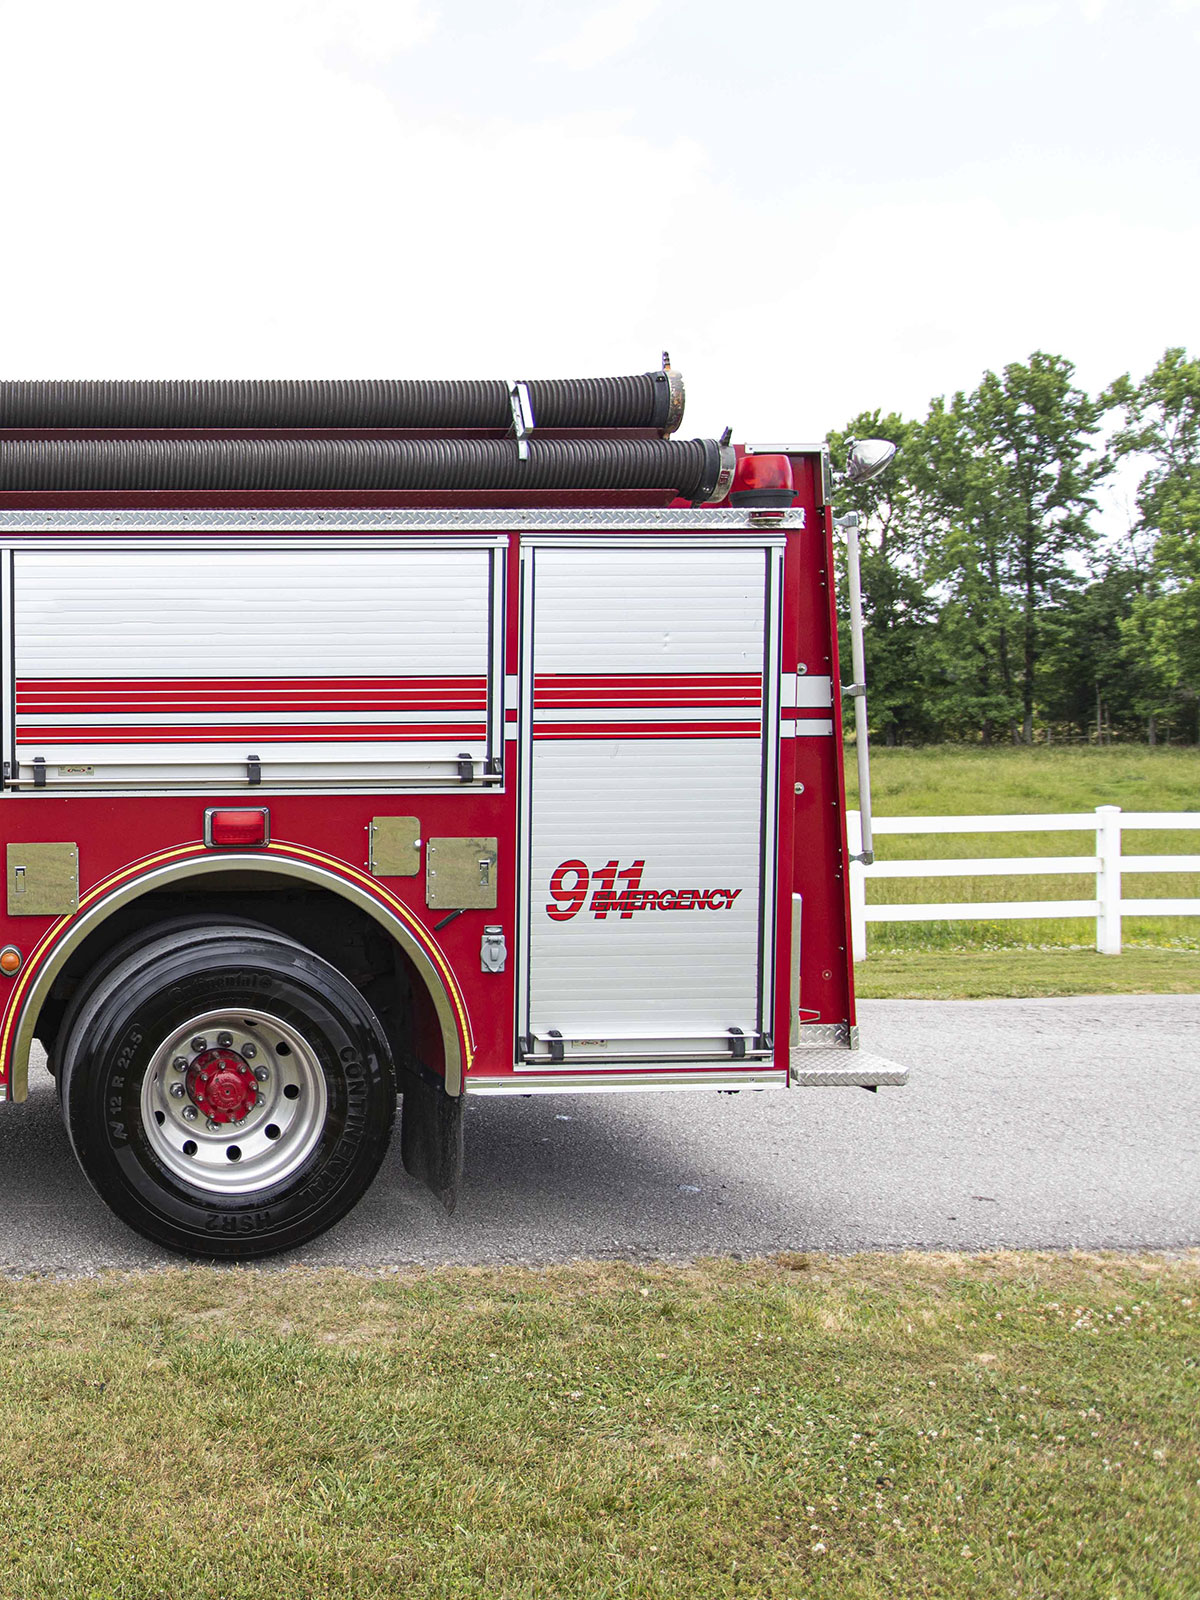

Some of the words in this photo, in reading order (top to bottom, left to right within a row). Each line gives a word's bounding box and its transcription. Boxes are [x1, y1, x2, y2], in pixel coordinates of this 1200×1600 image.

[545, 859, 646, 921] 911
[589, 888, 742, 911] EMERGENCY
[117, 1032, 143, 1069] 22.5
[111, 1075, 125, 1088] R
[110, 1096, 122, 1114] 12
[299, 1046, 368, 1205] CONTINENTAL
